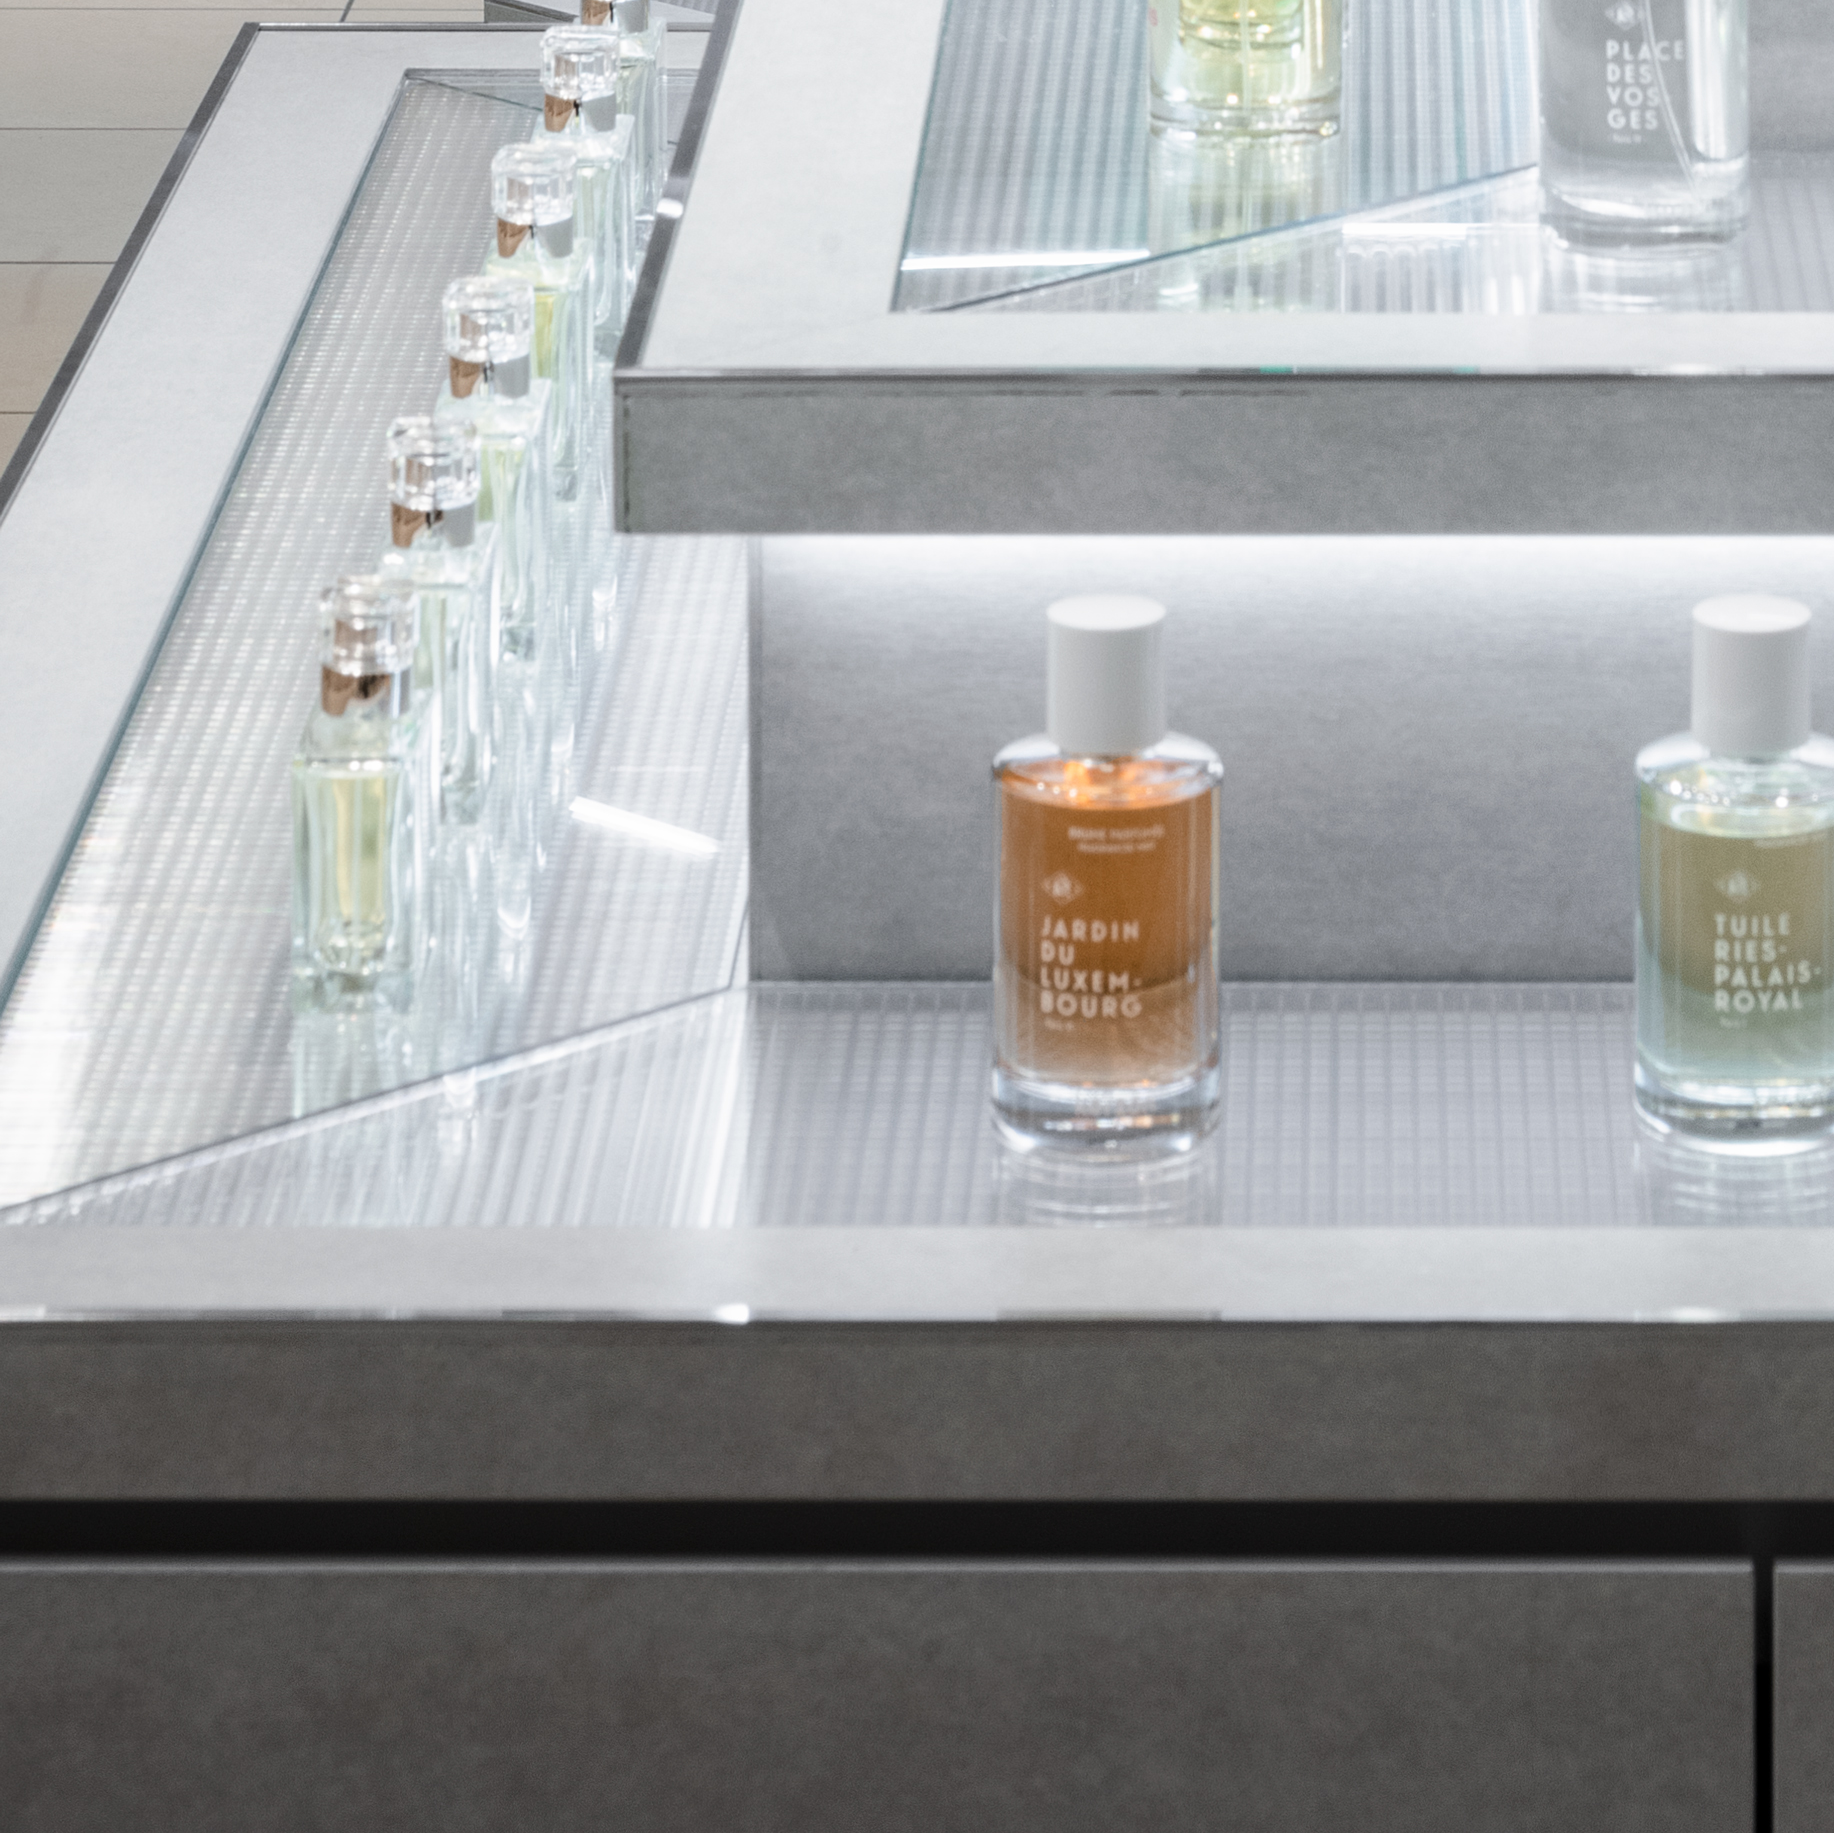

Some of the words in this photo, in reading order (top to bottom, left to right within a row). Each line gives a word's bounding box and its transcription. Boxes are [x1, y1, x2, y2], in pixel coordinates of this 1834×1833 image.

[1606, 38, 1684, 61] PLACE
[1606, 62, 1654, 85] DES
[1606, 85, 1661, 107] VOS
[1607, 107, 1659, 130] GES
[1041, 914, 1140, 943] JARDIN
[1714, 911, 1791, 938] TUILE
[1040, 939, 1075, 966] DU
[1040, 989, 1143, 1019] BOURG
[1714, 987, 1803, 1014] ROYAL
